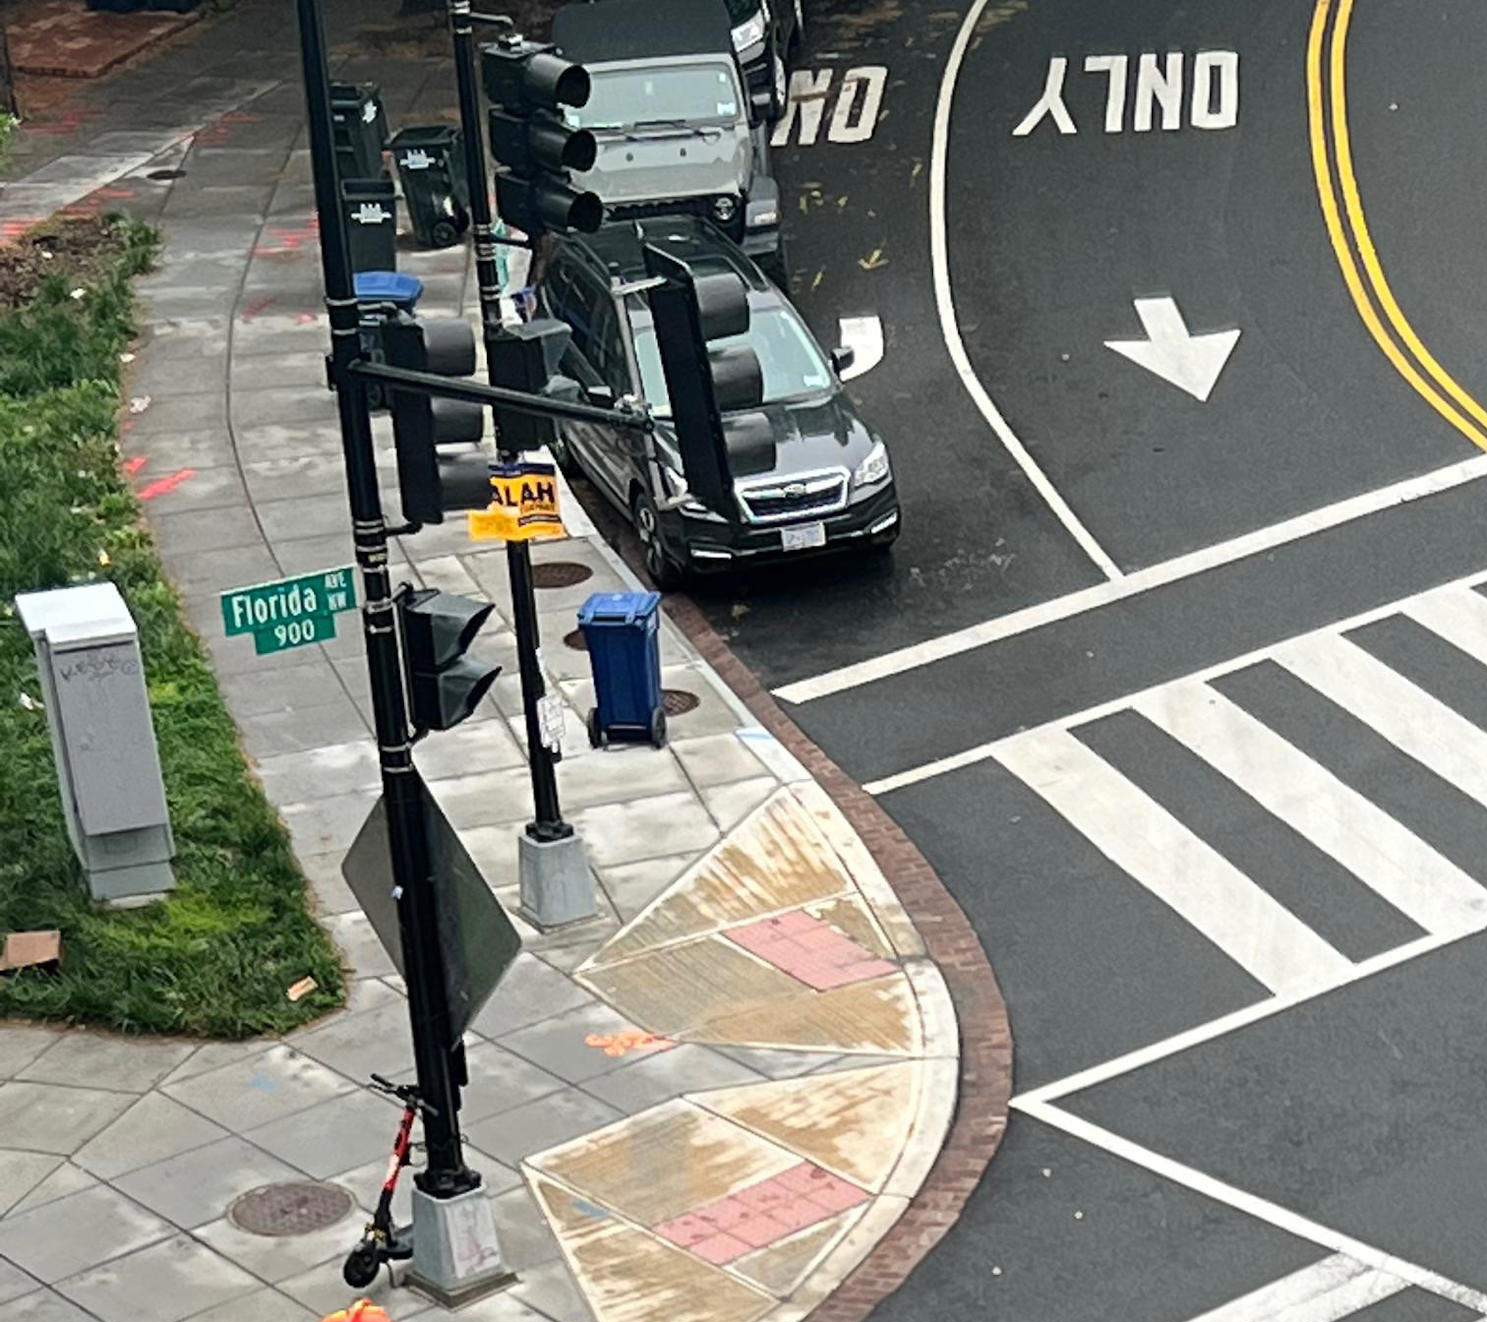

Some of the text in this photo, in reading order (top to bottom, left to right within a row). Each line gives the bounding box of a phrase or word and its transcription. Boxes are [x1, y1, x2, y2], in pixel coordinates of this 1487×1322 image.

[1011, 50, 1238, 136] ONLY
[487, 482, 555, 507] ALAH
[232, 583, 317, 628] Florida
[327, 591, 347, 611] NW
[274, 619, 315, 647] 900
